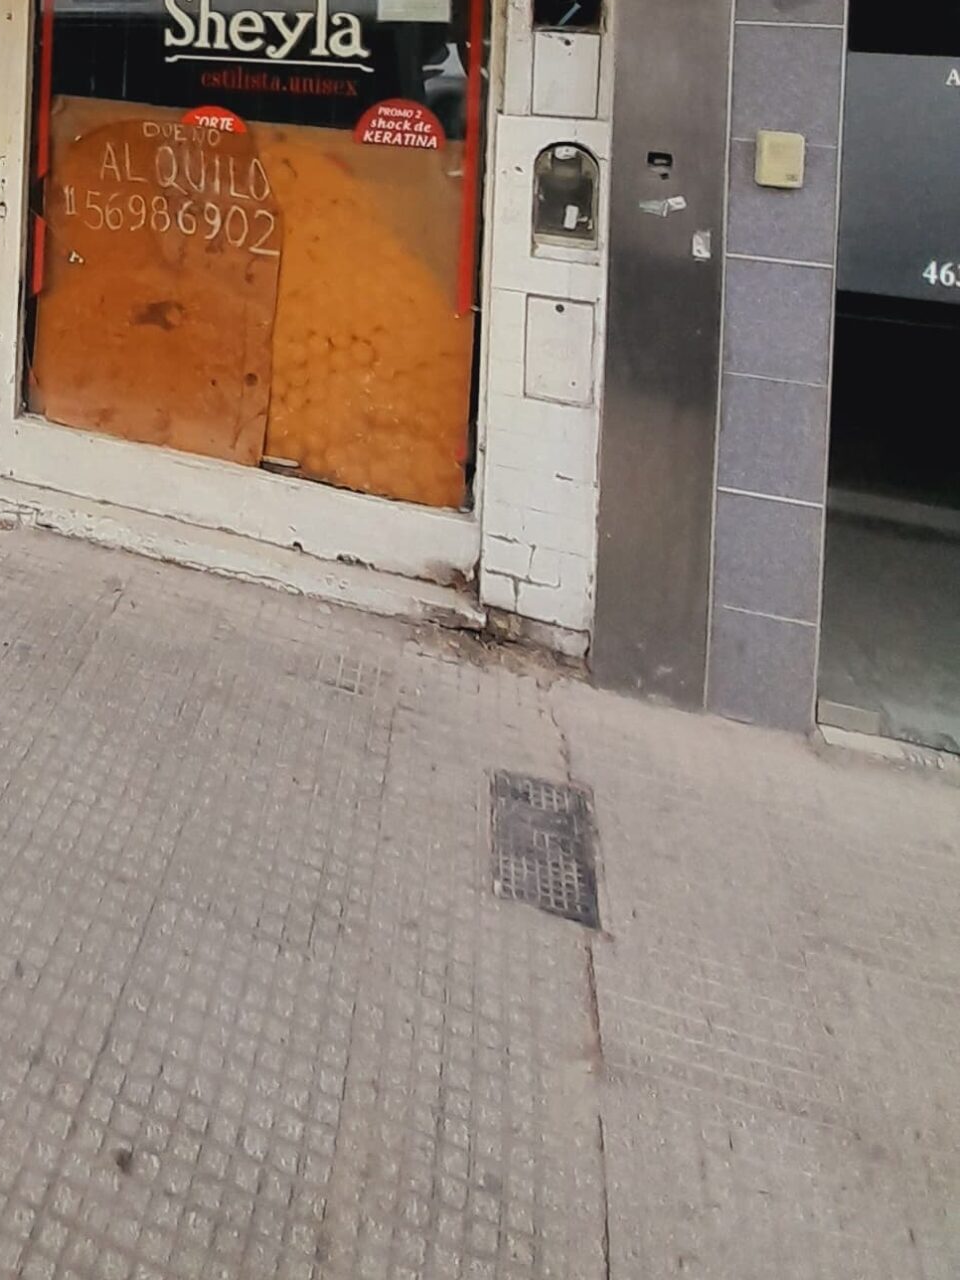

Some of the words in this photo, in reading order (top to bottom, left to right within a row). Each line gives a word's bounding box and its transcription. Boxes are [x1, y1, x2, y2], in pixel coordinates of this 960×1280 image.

[377, 106, 413, 119] PROMO
[415, 109, 423, 119] 2
[195, 115, 235, 131] ORTE
[370, 117, 411, 131] shock
[413, 121, 432, 133] de
[363, 129, 438, 149] KERATINA
